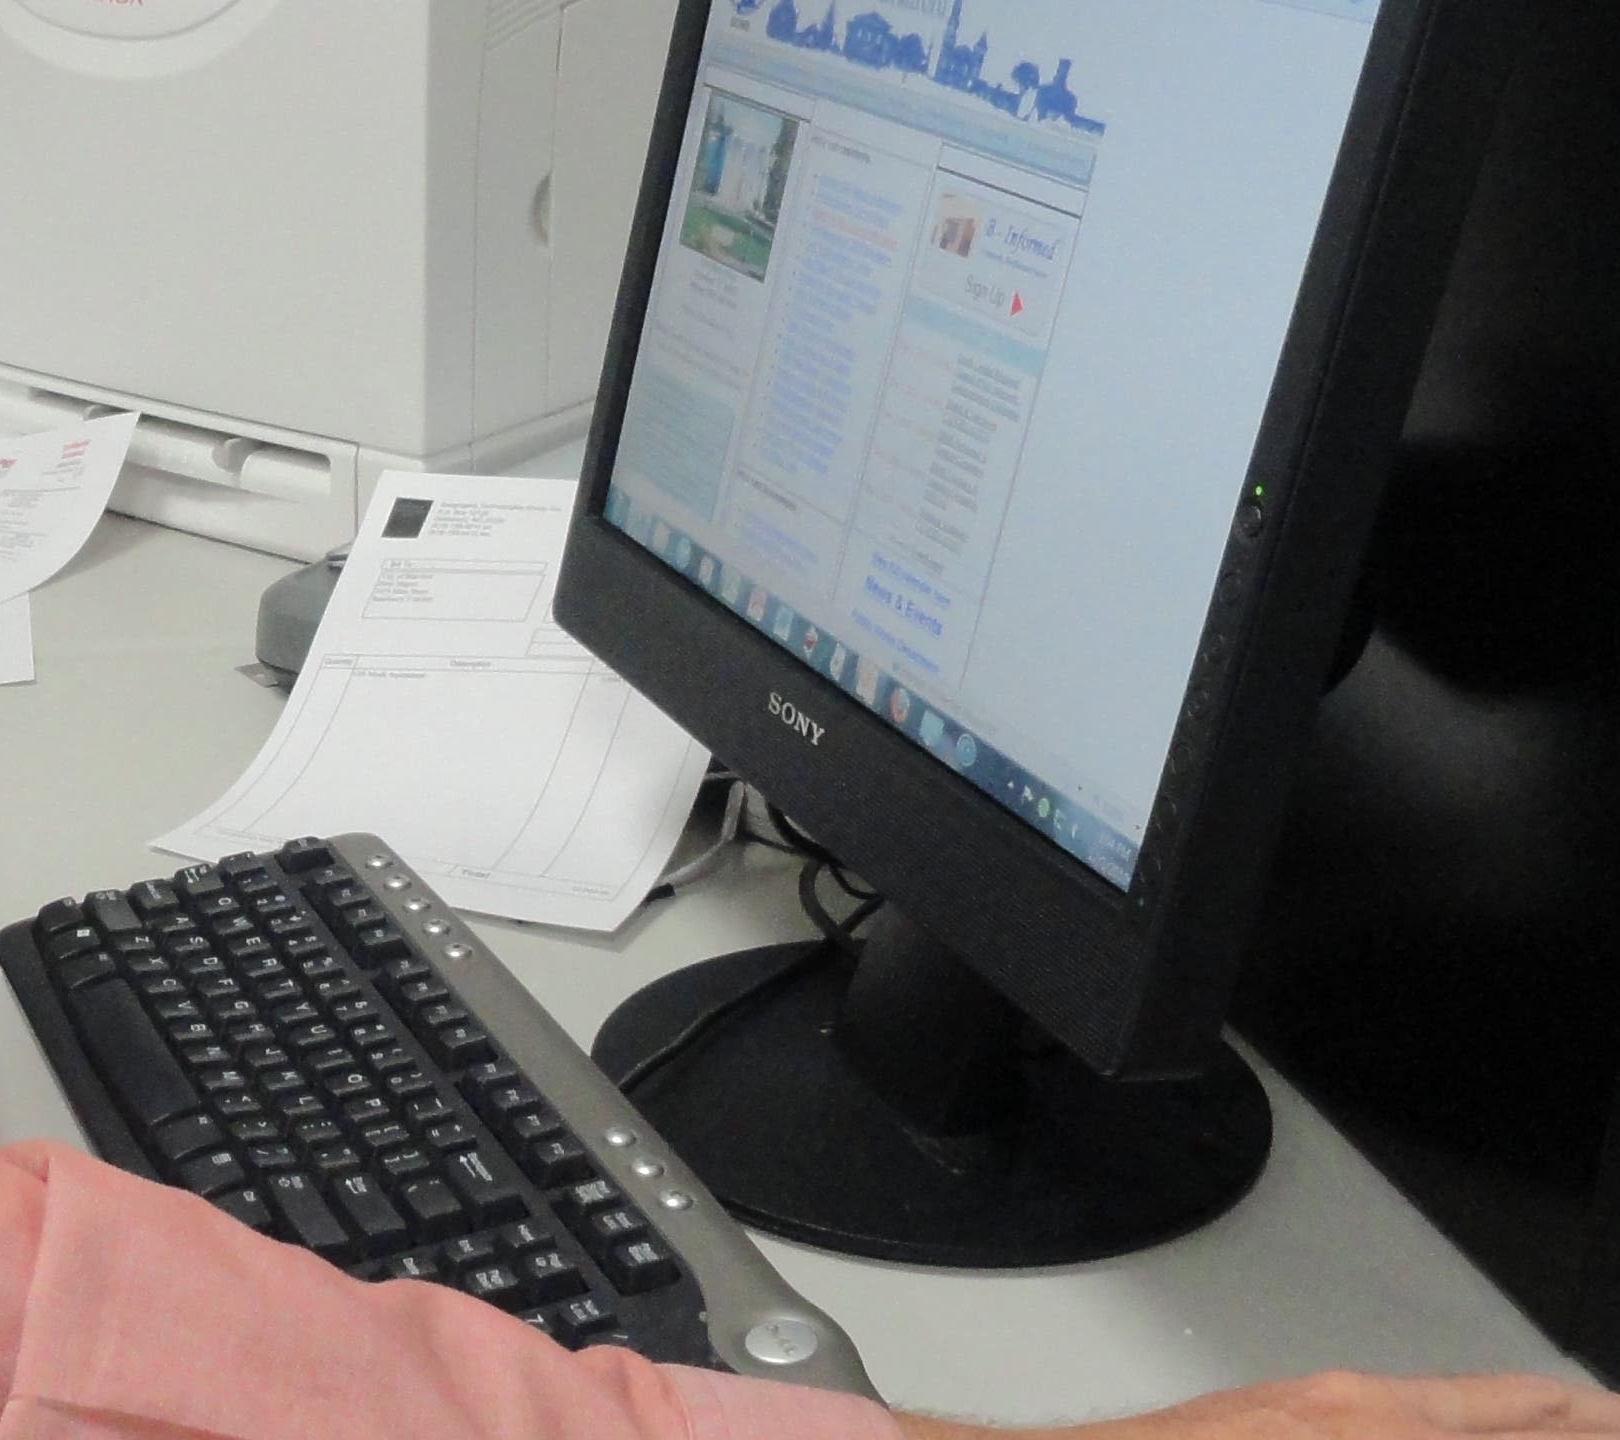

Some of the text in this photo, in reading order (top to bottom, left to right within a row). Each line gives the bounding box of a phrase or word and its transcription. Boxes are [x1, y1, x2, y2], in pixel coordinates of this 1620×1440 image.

[1004, 224, 1062, 261] Informed
[965, 273, 1006, 308] Sign Up
[905, 598, 943, 638] Events
[768, 691, 825, 746] SONY
